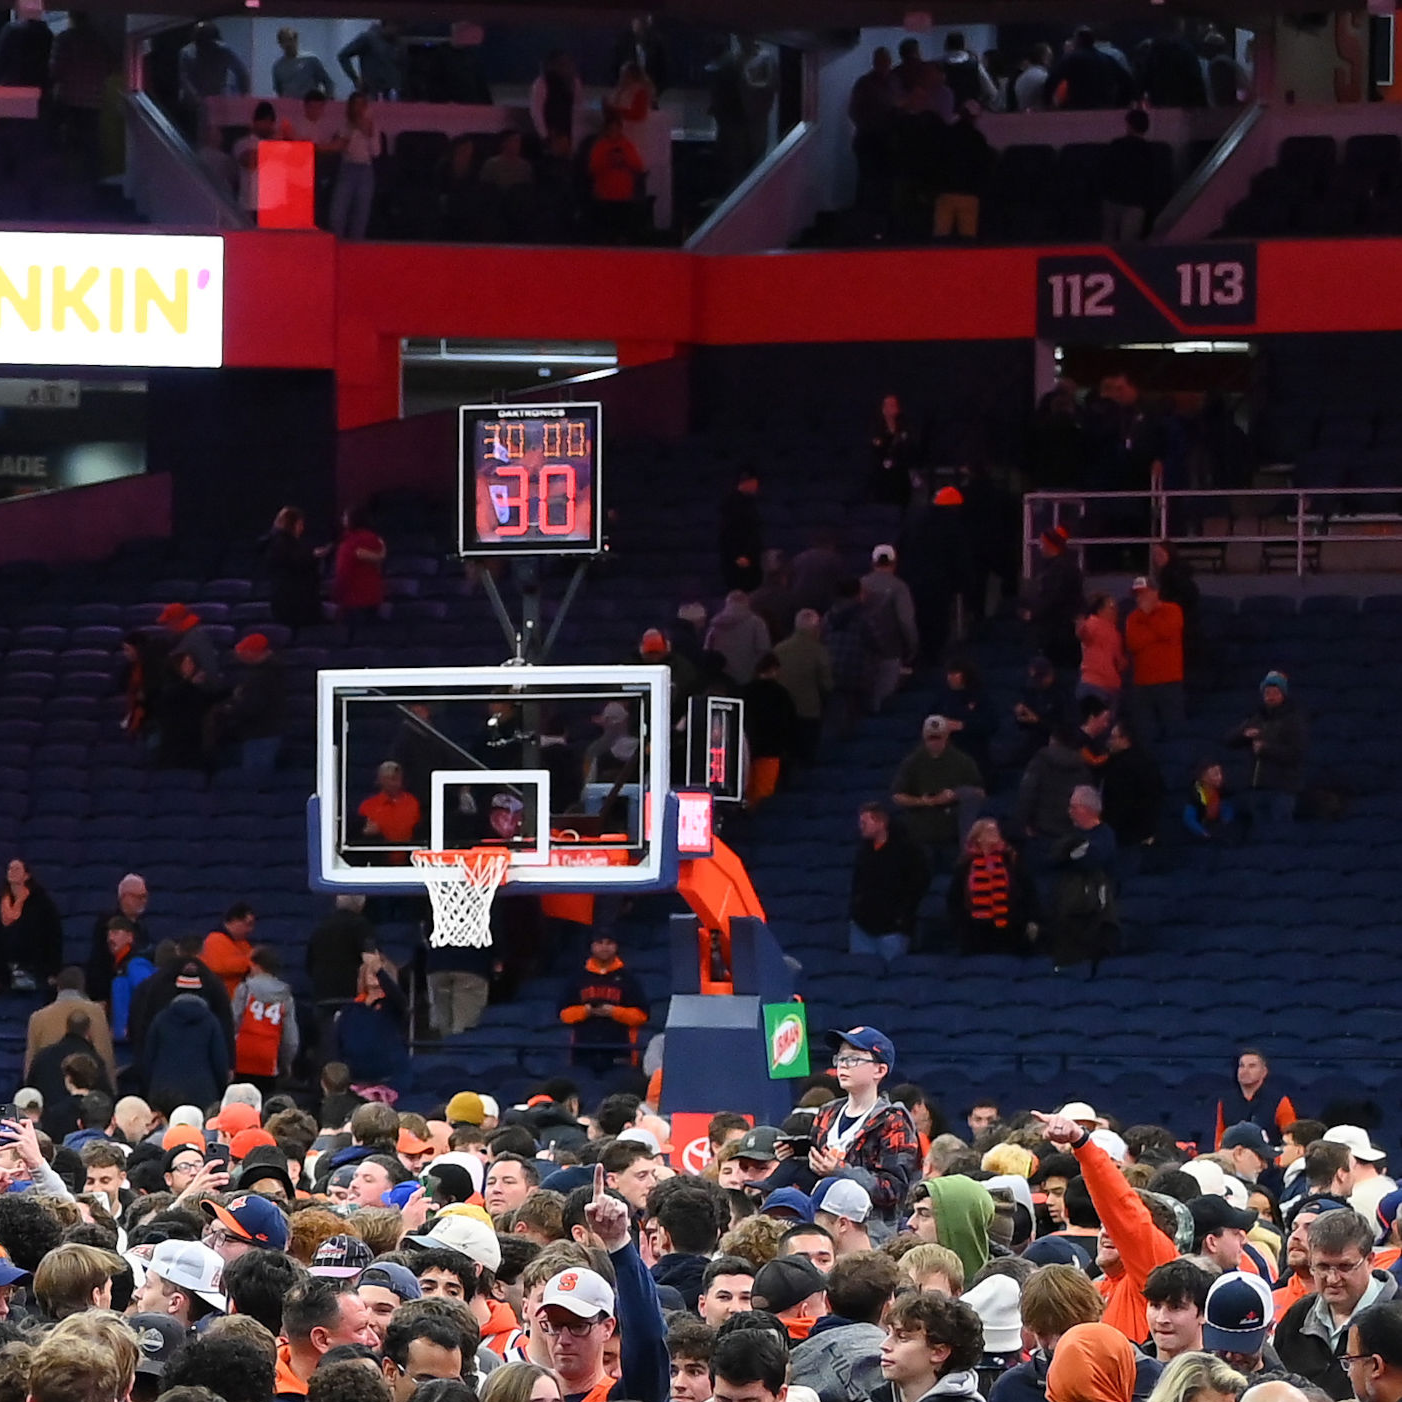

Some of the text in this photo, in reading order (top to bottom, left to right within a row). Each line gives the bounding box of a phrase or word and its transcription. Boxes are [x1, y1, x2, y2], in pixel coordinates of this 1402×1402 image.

[1048, 273, 1116, 317] 112
[1176, 261, 1245, 306] 113
[498, 408, 566, 420] DAKTRONICS
[494, 464, 578, 537] 30
[250, 1000, 282, 1025] 44
[557, 1272, 578, 1292] S
